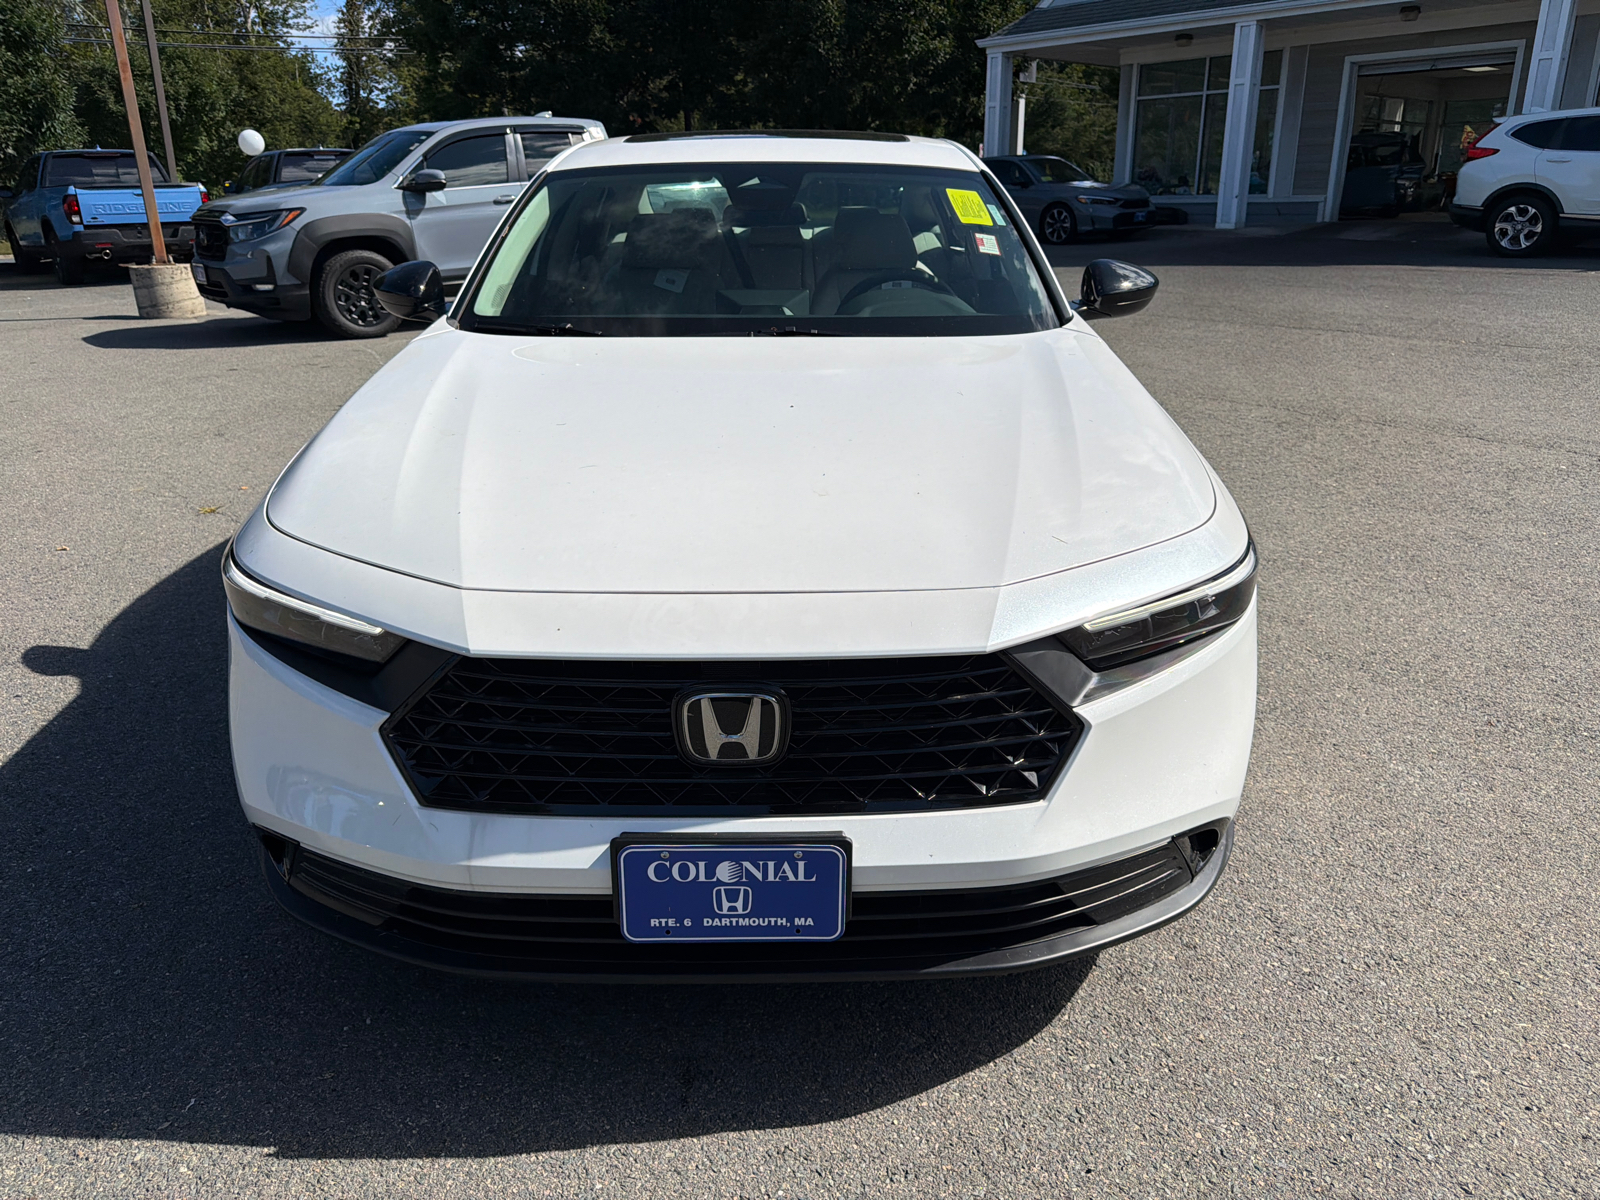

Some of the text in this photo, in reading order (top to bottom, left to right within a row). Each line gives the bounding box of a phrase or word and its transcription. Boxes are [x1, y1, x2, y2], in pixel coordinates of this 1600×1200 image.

[647, 860, 817, 883] COLONIAL
[650, 917, 815, 927] RTE. 6 DARTMOUTH, MA
